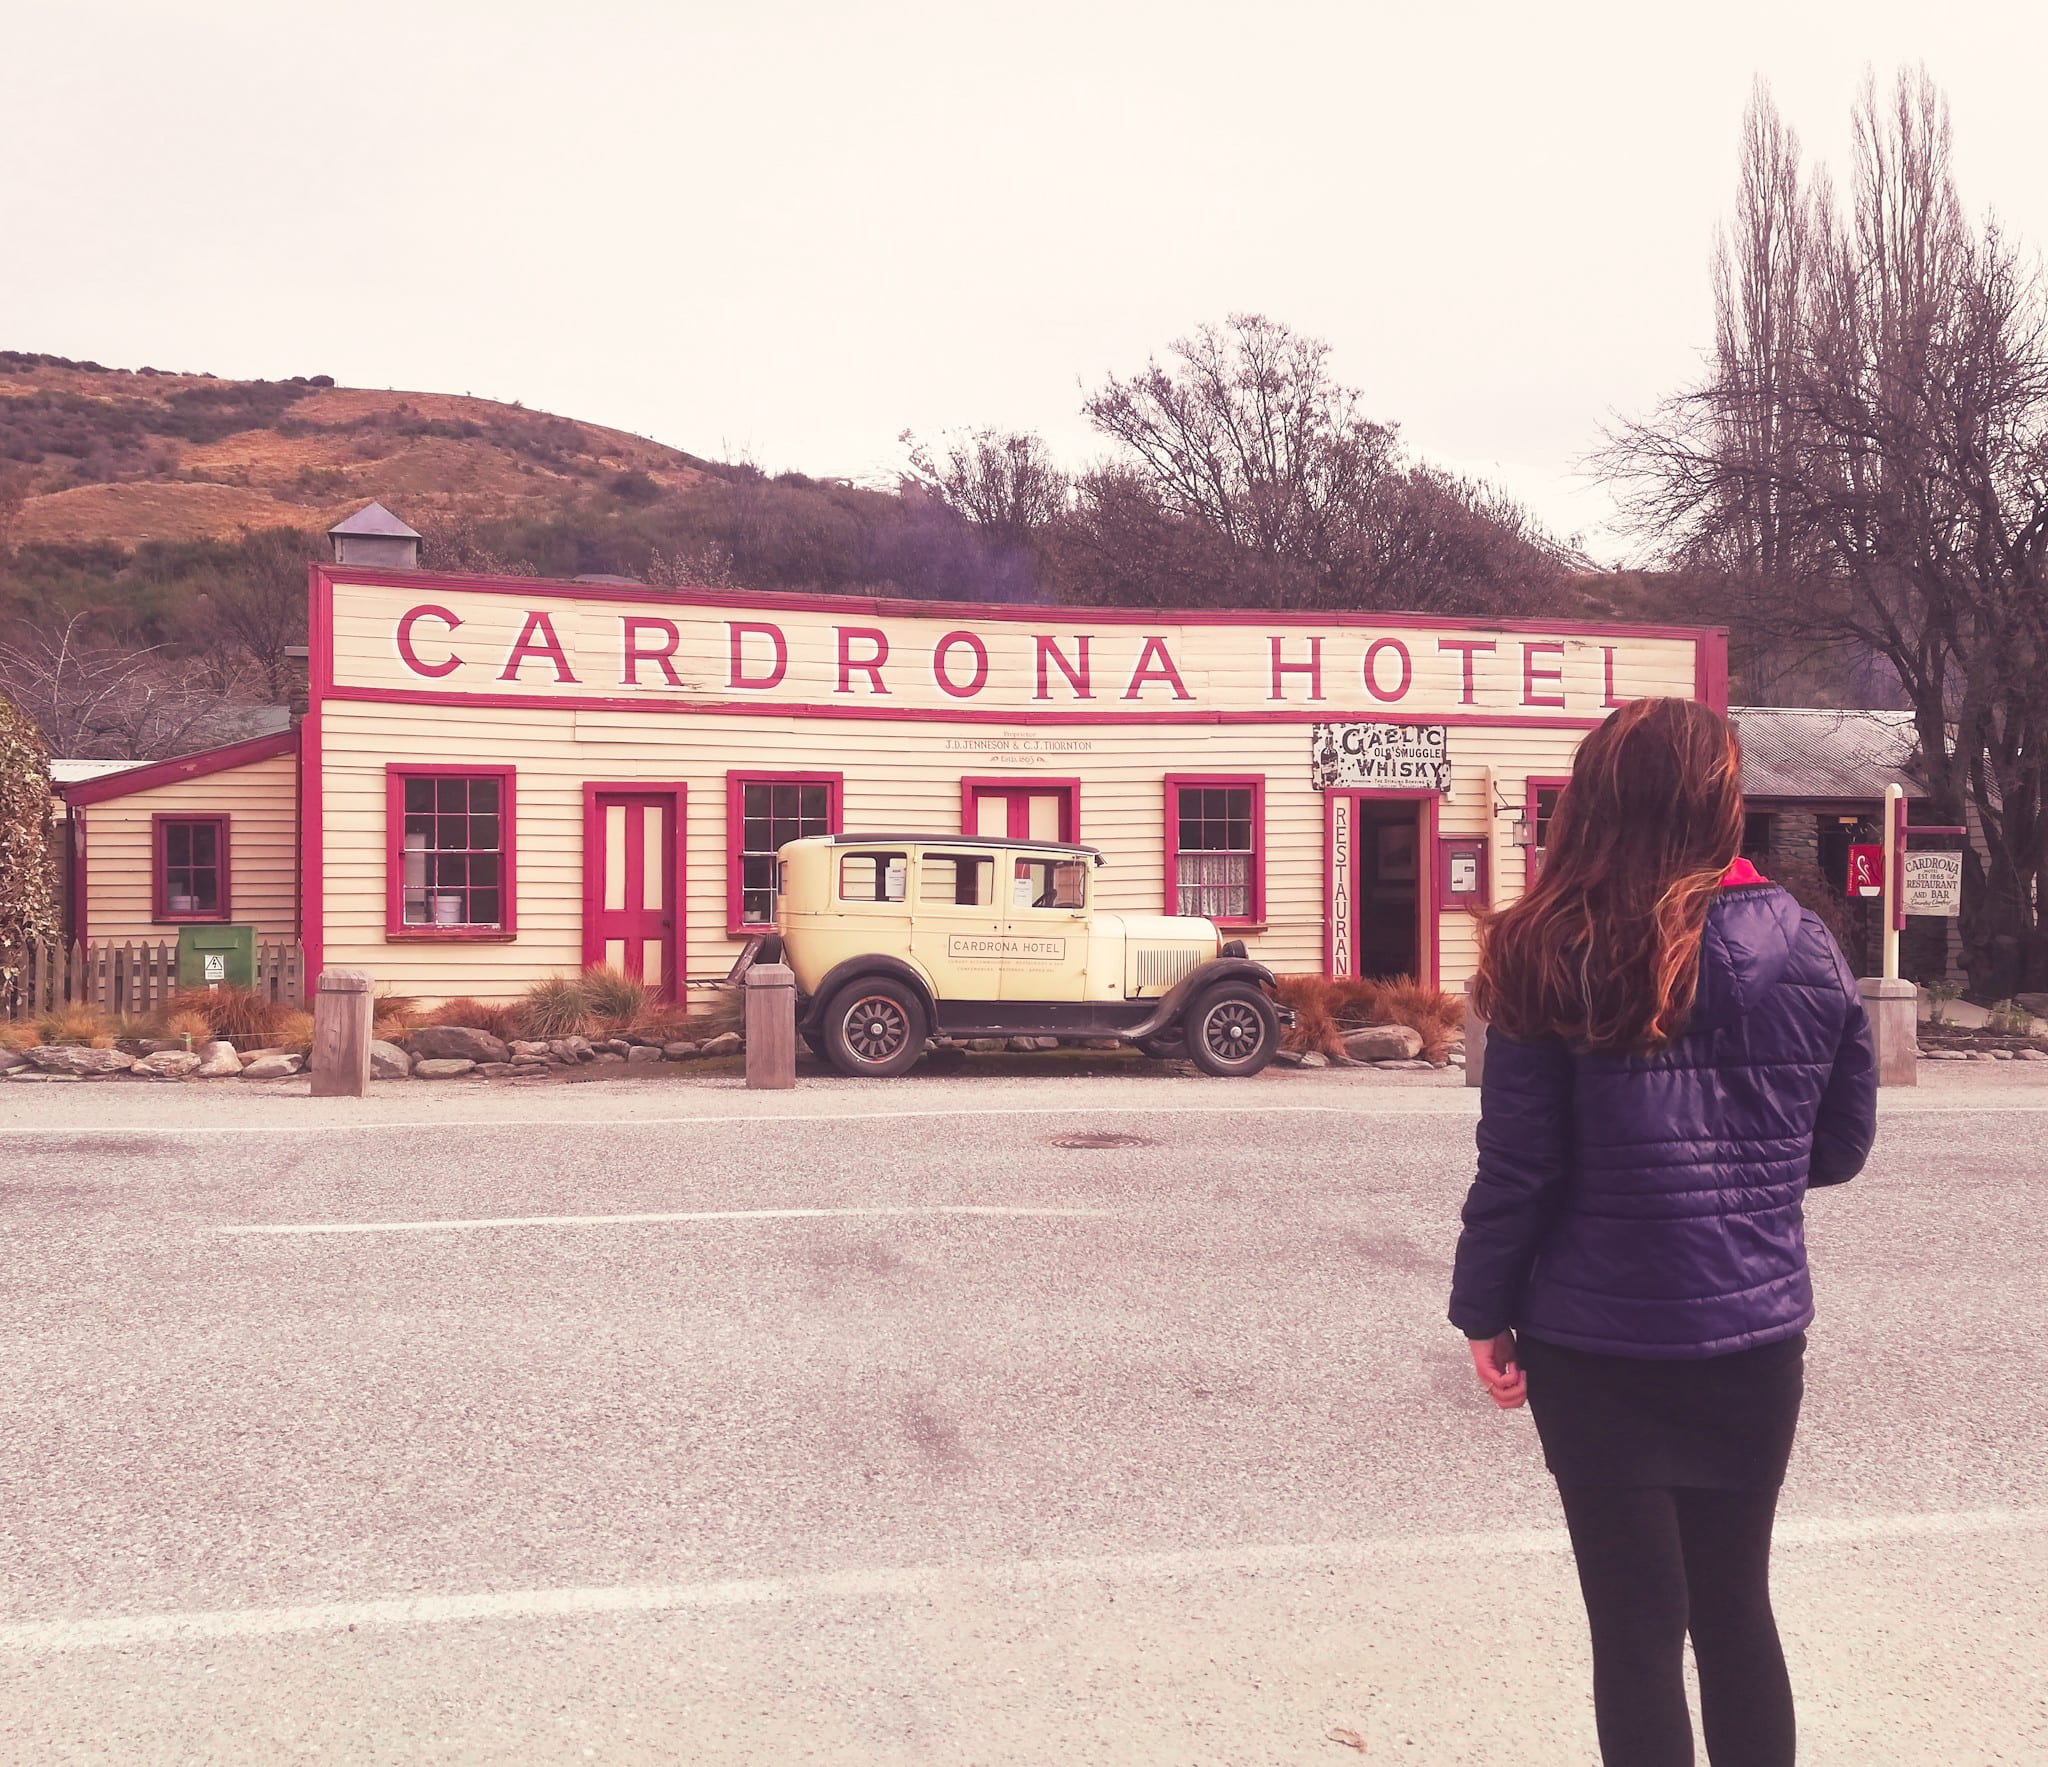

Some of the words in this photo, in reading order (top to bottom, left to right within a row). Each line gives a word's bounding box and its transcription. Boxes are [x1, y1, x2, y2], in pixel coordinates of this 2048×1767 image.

[396, 603, 1197, 700] CARDRONA
[1266, 636, 1632, 709] HOTEL
[1012, 741, 1020, 750] &
[1356, 758, 1442, 778] WHISKY
[1905, 858, 1959, 875] CARDRONA
[1906, 880, 1958, 889] RESTAURANT
[1334, 807, 1348, 981] RESTAURAN
[1931, 890, 1949, 898] BAR
[953, 941, 1018, 952] CARDRONA
[1023, 943, 1060, 953] HOTEL
